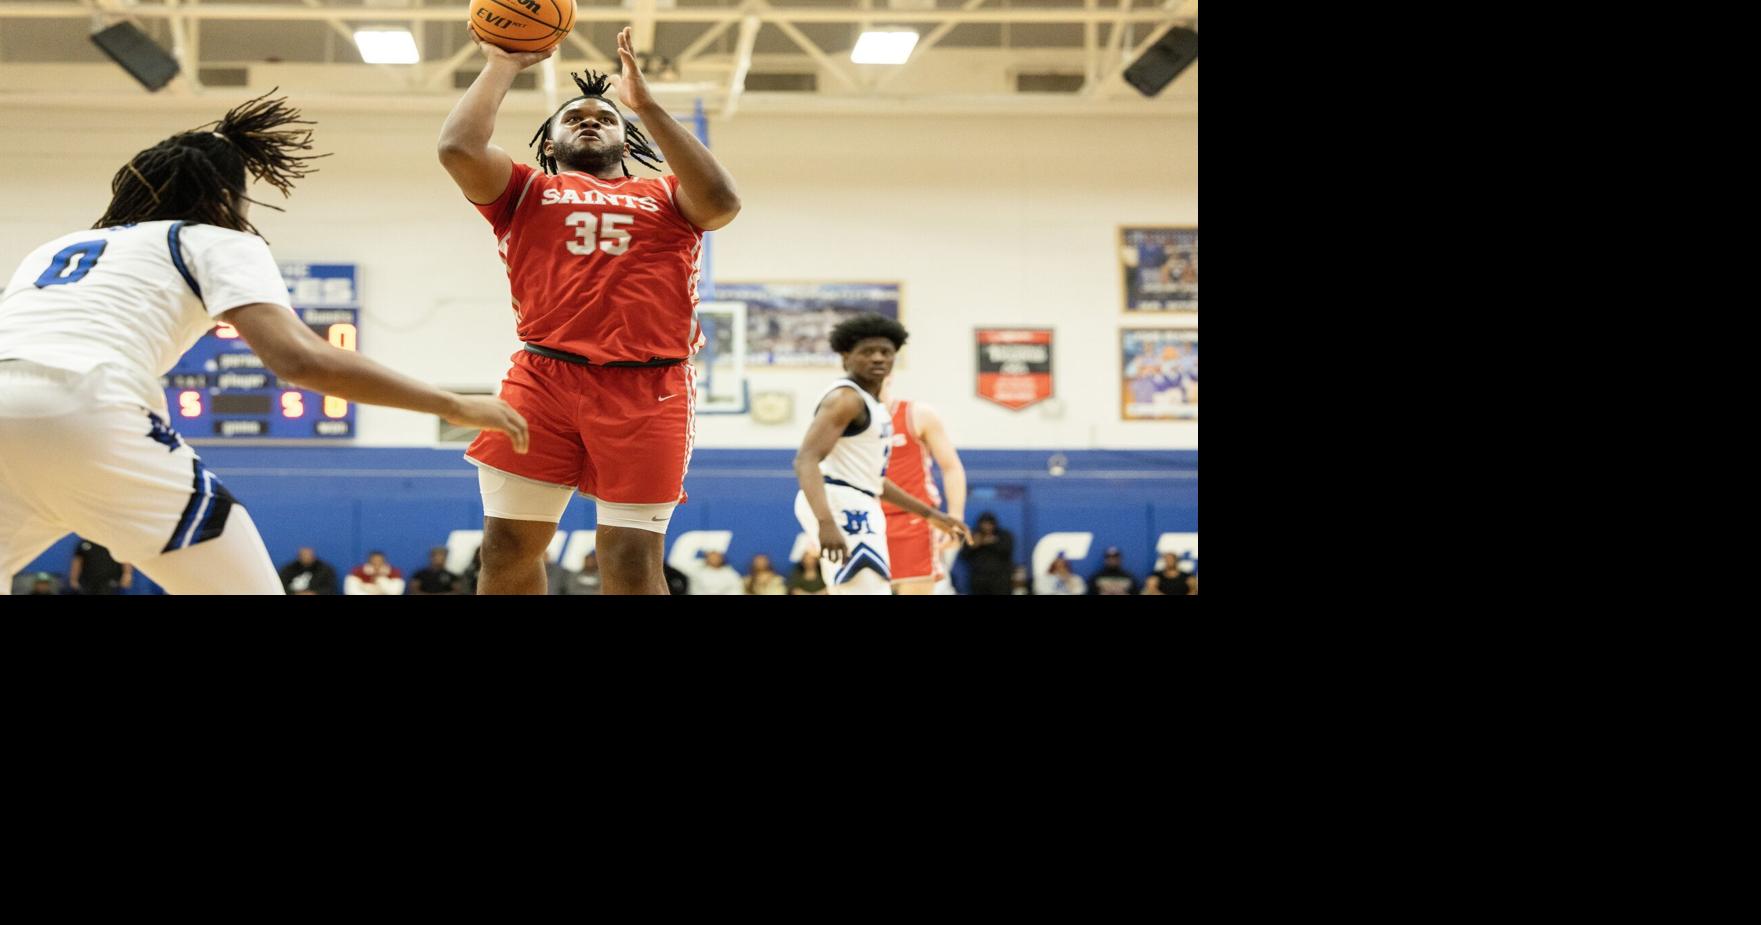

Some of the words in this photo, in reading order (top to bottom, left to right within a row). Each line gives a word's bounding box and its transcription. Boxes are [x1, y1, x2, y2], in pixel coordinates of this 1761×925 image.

[476, 7, 513, 29] EVO
[541, 188, 660, 212] SAINTS
[564, 211, 635, 256] 35
[33, 239, 108, 289] 0
